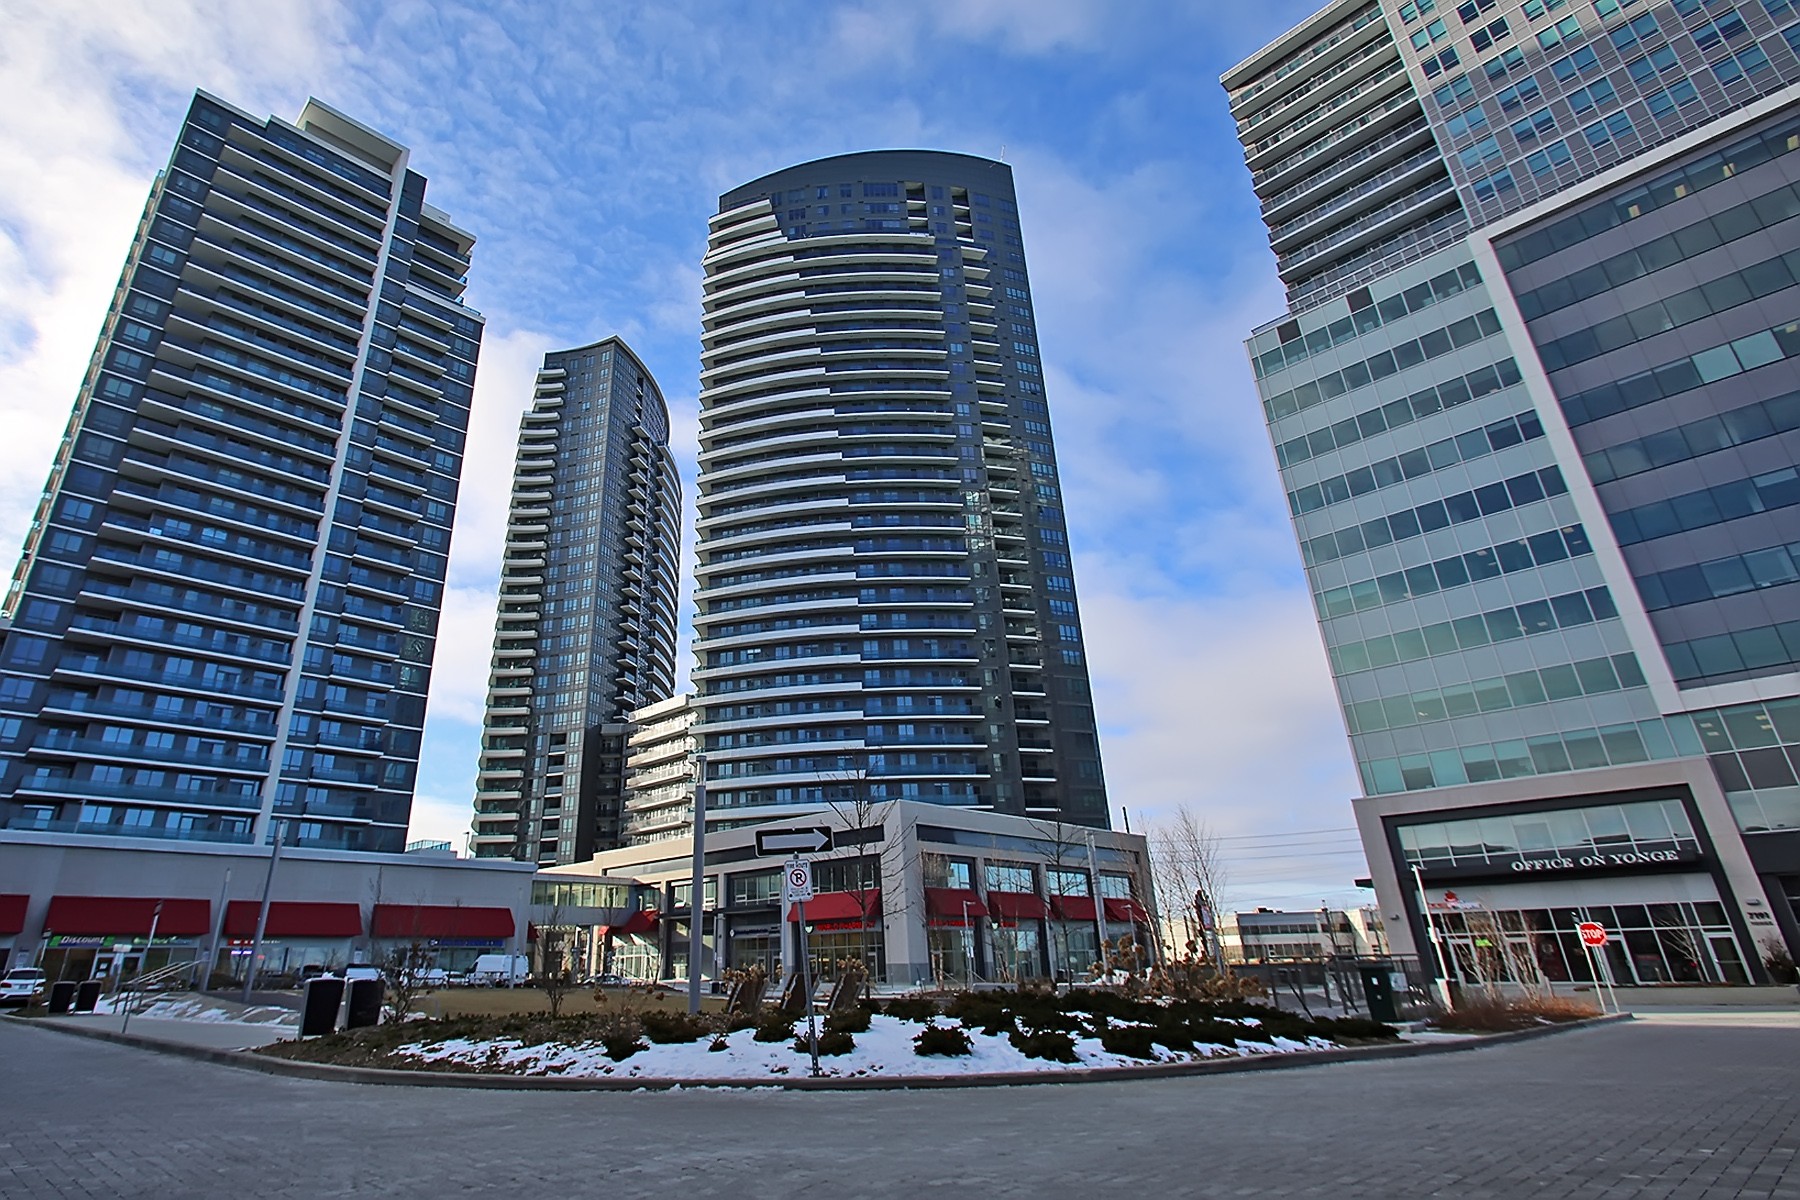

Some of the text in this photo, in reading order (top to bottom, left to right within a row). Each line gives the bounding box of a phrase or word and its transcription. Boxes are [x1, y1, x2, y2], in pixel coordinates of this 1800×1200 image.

[1511, 850, 1679, 872] OFFICE ON YONGE
[1581, 928, 1603, 939] STOP
[60, 935, 105, 944] Discount
